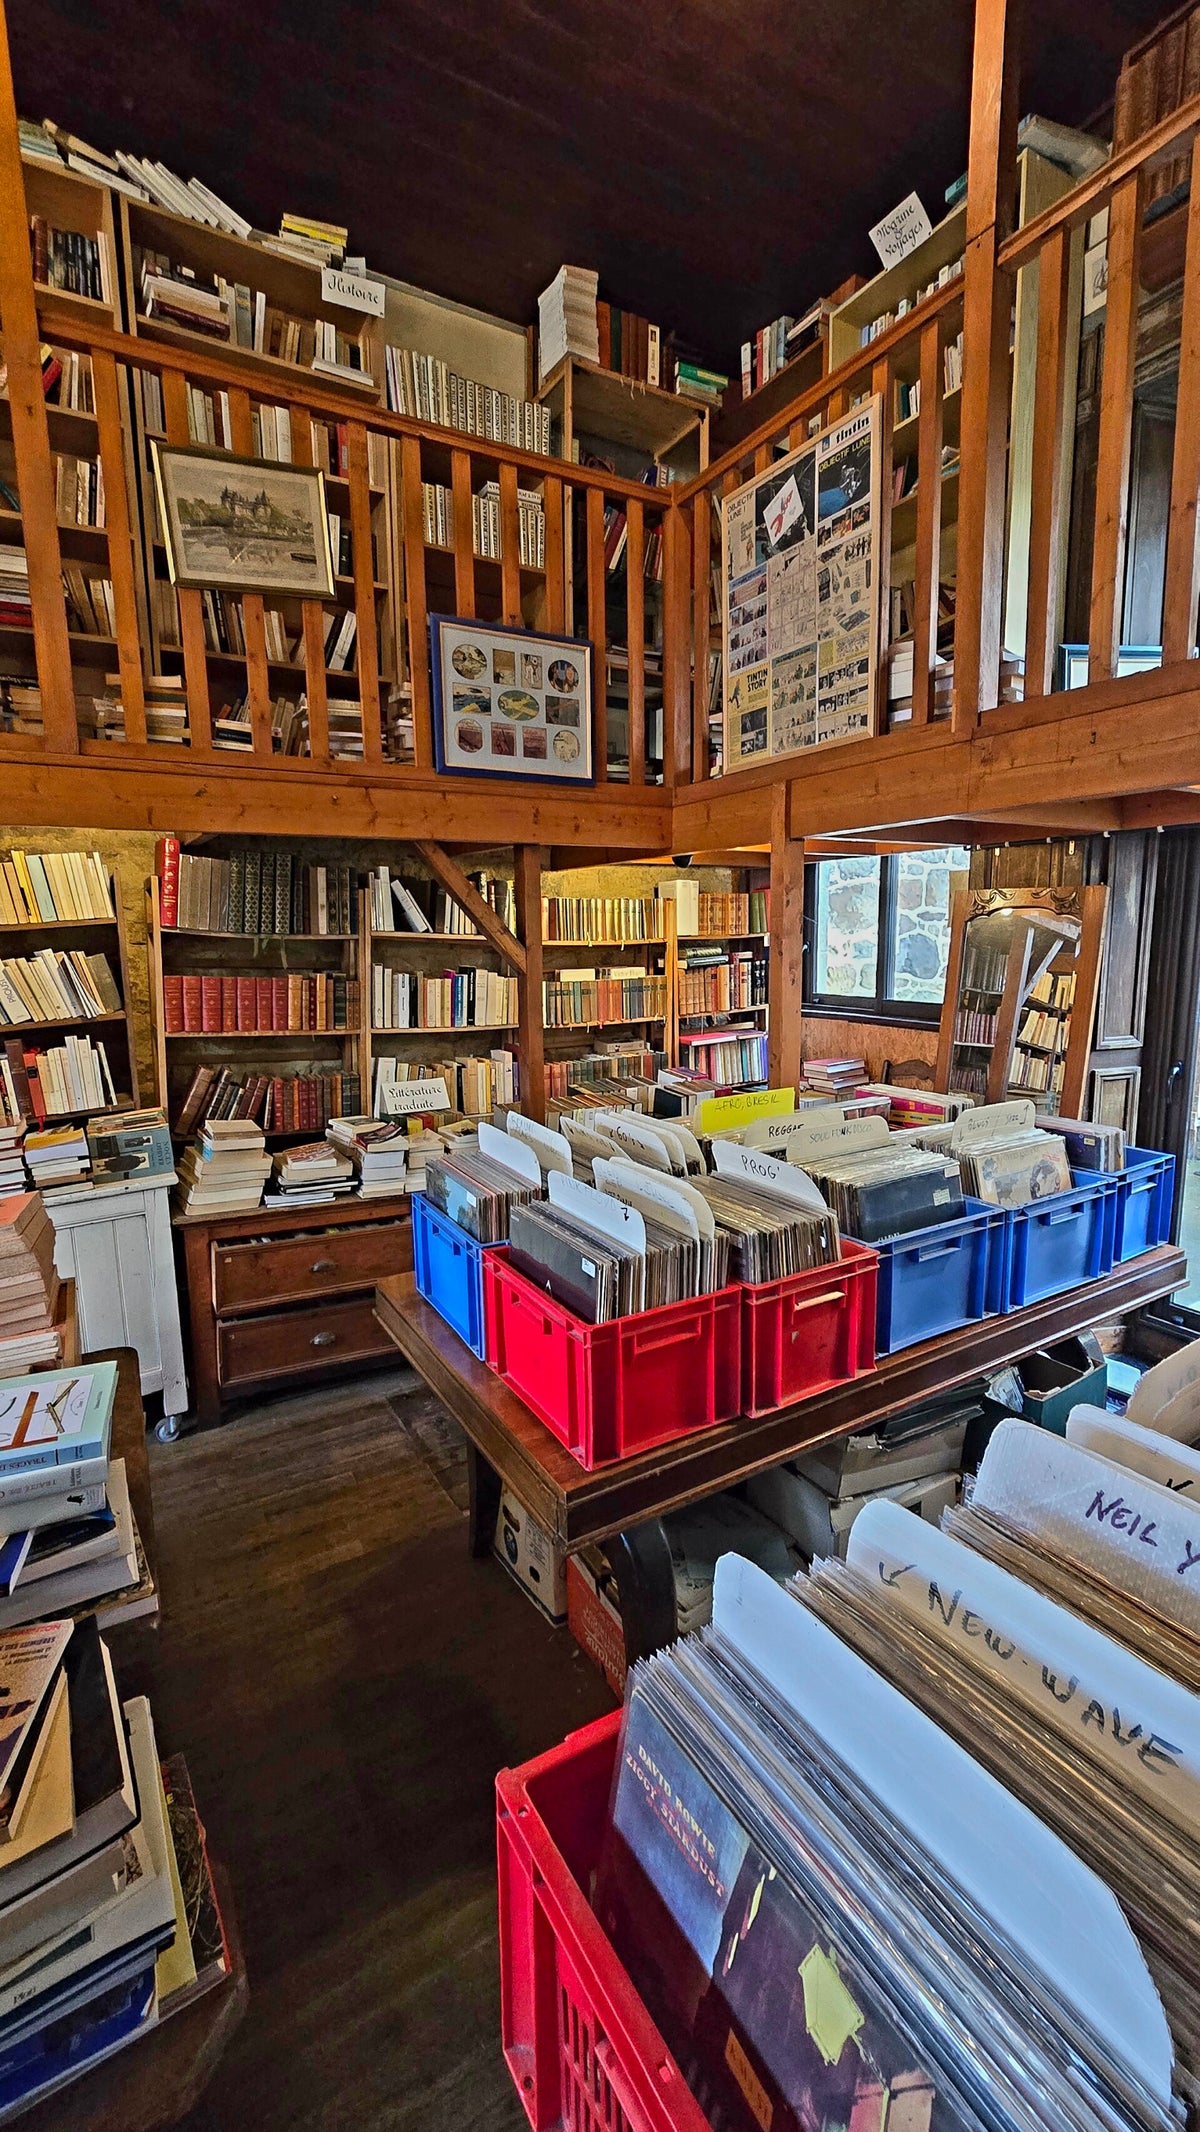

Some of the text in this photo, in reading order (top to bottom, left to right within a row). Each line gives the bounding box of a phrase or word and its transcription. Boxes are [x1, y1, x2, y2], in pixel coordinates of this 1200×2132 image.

[885, 221, 923, 257] Voyages
[328, 274, 378, 304] Histoire
[836, 416, 869, 444] tintin
[818, 434, 871, 473] OBJECTIF LUNE
[727, 491, 754, 514] OBJECTIF
[747, 667, 768, 682] TINTIN
[747, 679, 767, 693] STORY
[388, 1086, 442, 1099] Littérature
[394, 1099, 434, 1111] traduite
[9, 1456, 47, 1471] TRACES
[1085, 1490, 1157, 1547] NEIL
[638, 1744, 672, 1797] DAVID
[675, 1794, 716, 1860] BOWIE
[625, 1751, 657, 1801] ZIGGY
[659, 1802, 725, 1897] STARDUST
